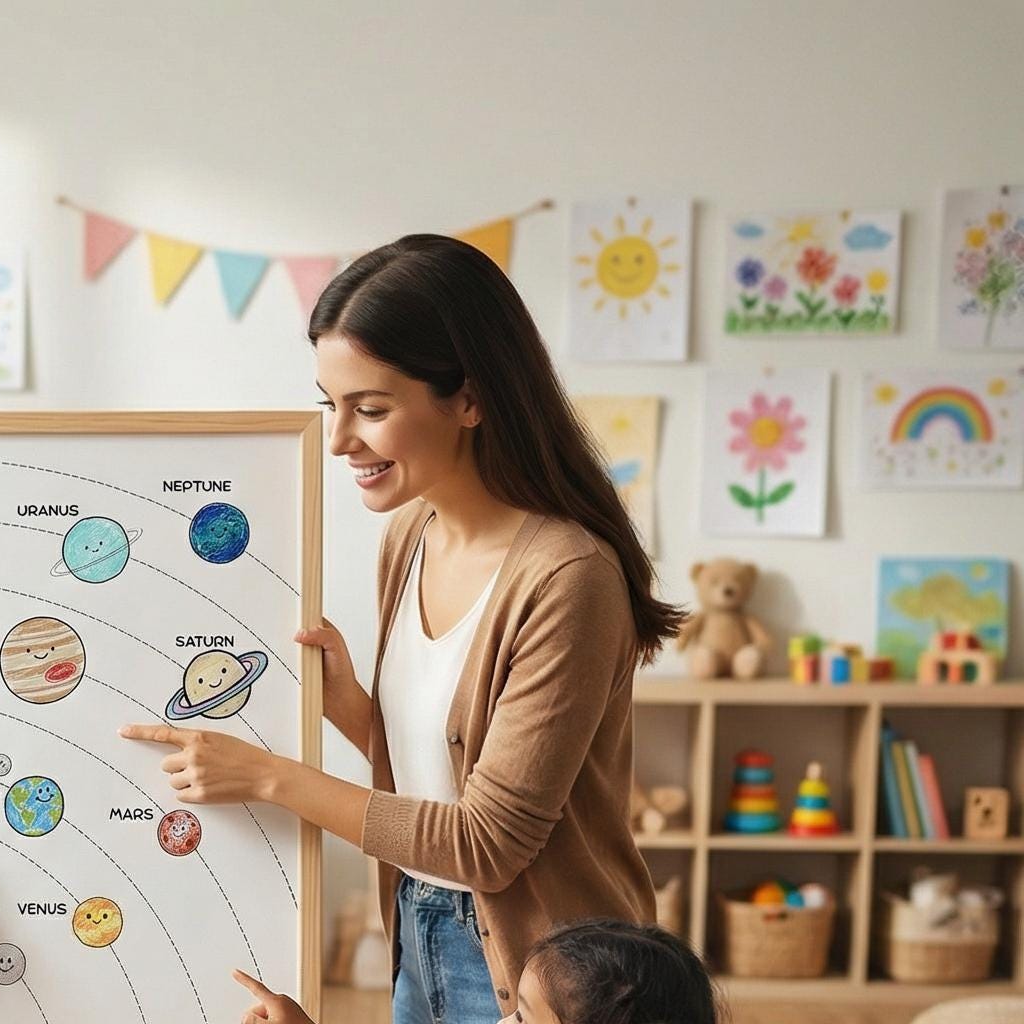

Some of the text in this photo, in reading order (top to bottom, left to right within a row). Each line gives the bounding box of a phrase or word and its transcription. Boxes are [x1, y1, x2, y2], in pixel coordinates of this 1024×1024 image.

[163, 480, 232, 493] NEPTUNE
[17, 504, 79, 517] URANUS
[175, 635, 235, 648] SATURN
[109, 807, 154, 821] MARS
[17, 902, 68, 916] VENUS
